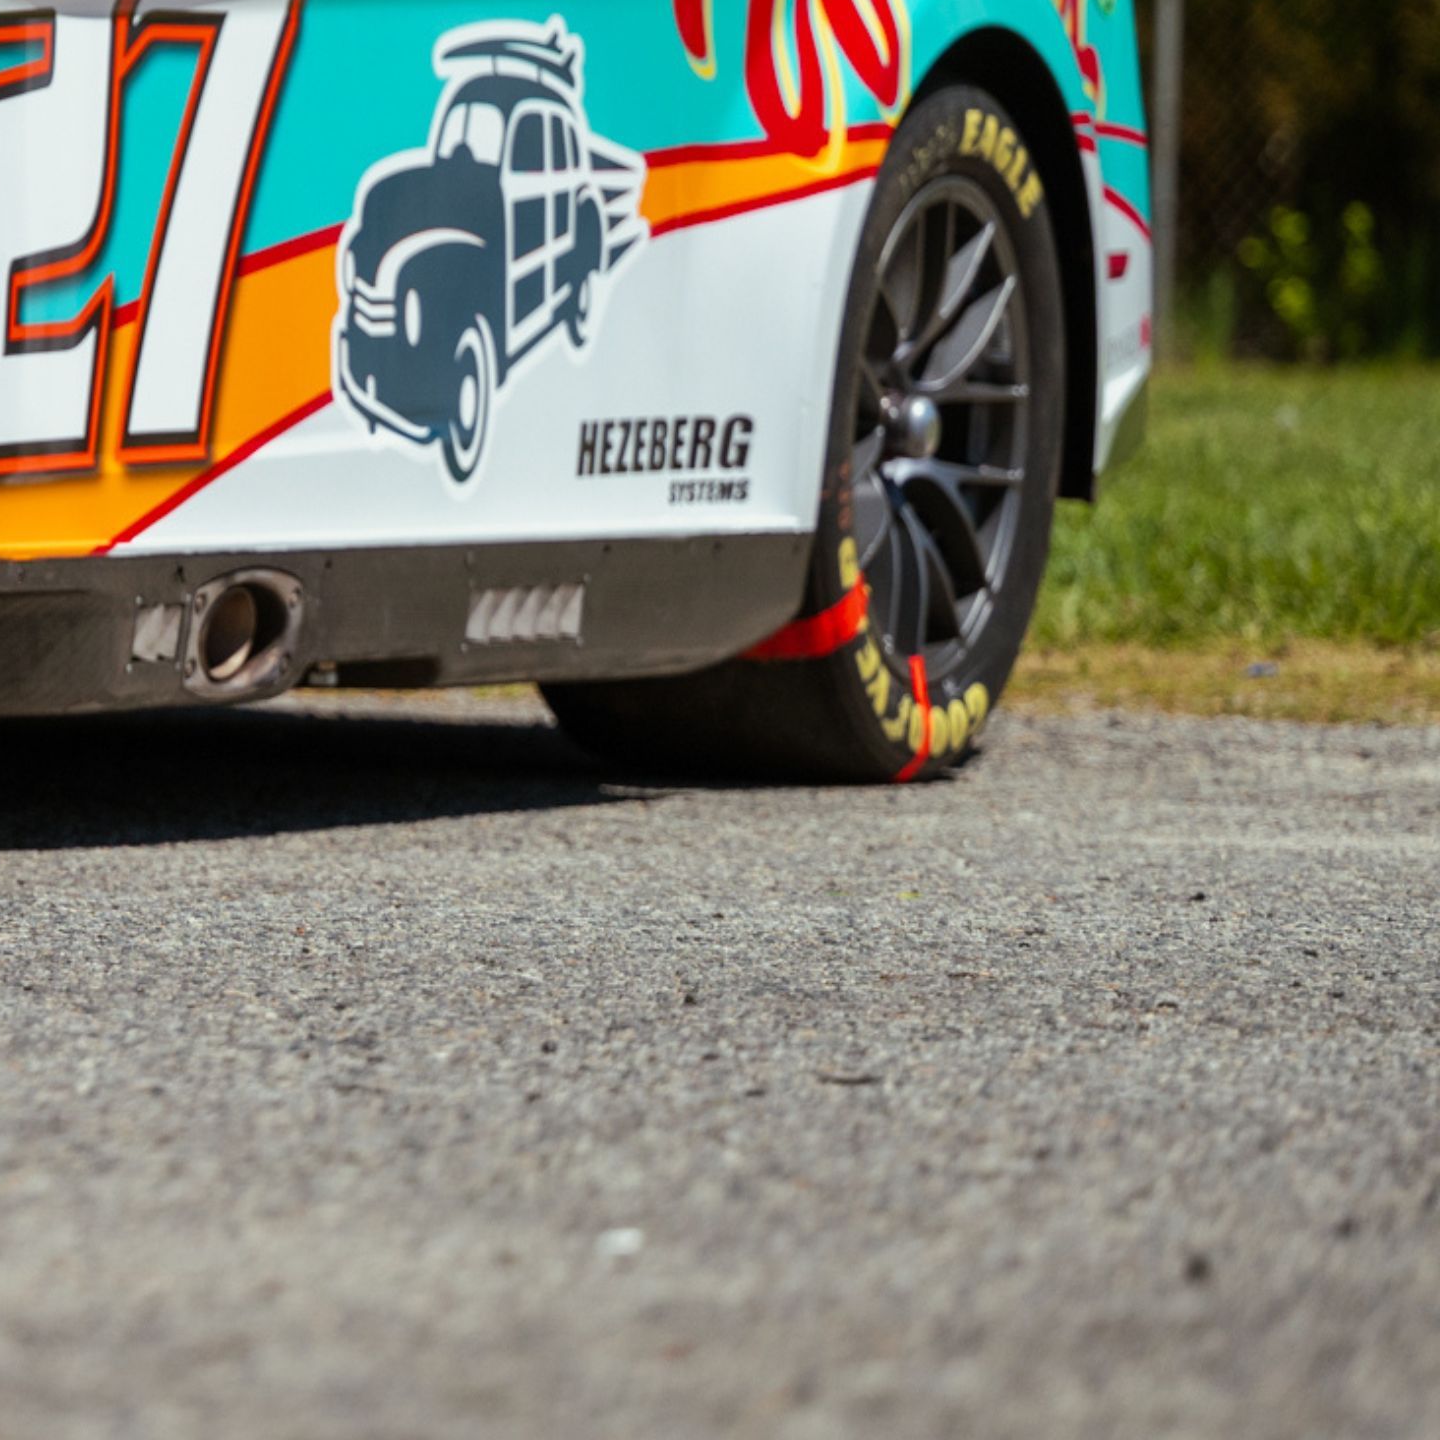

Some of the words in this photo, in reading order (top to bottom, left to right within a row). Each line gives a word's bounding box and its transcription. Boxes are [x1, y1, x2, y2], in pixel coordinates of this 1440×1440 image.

[958, 107, 1044, 220] EAGLE
[577, 413, 754, 476] HEZEBERG
[669, 480, 749, 503] SYSTEMS
